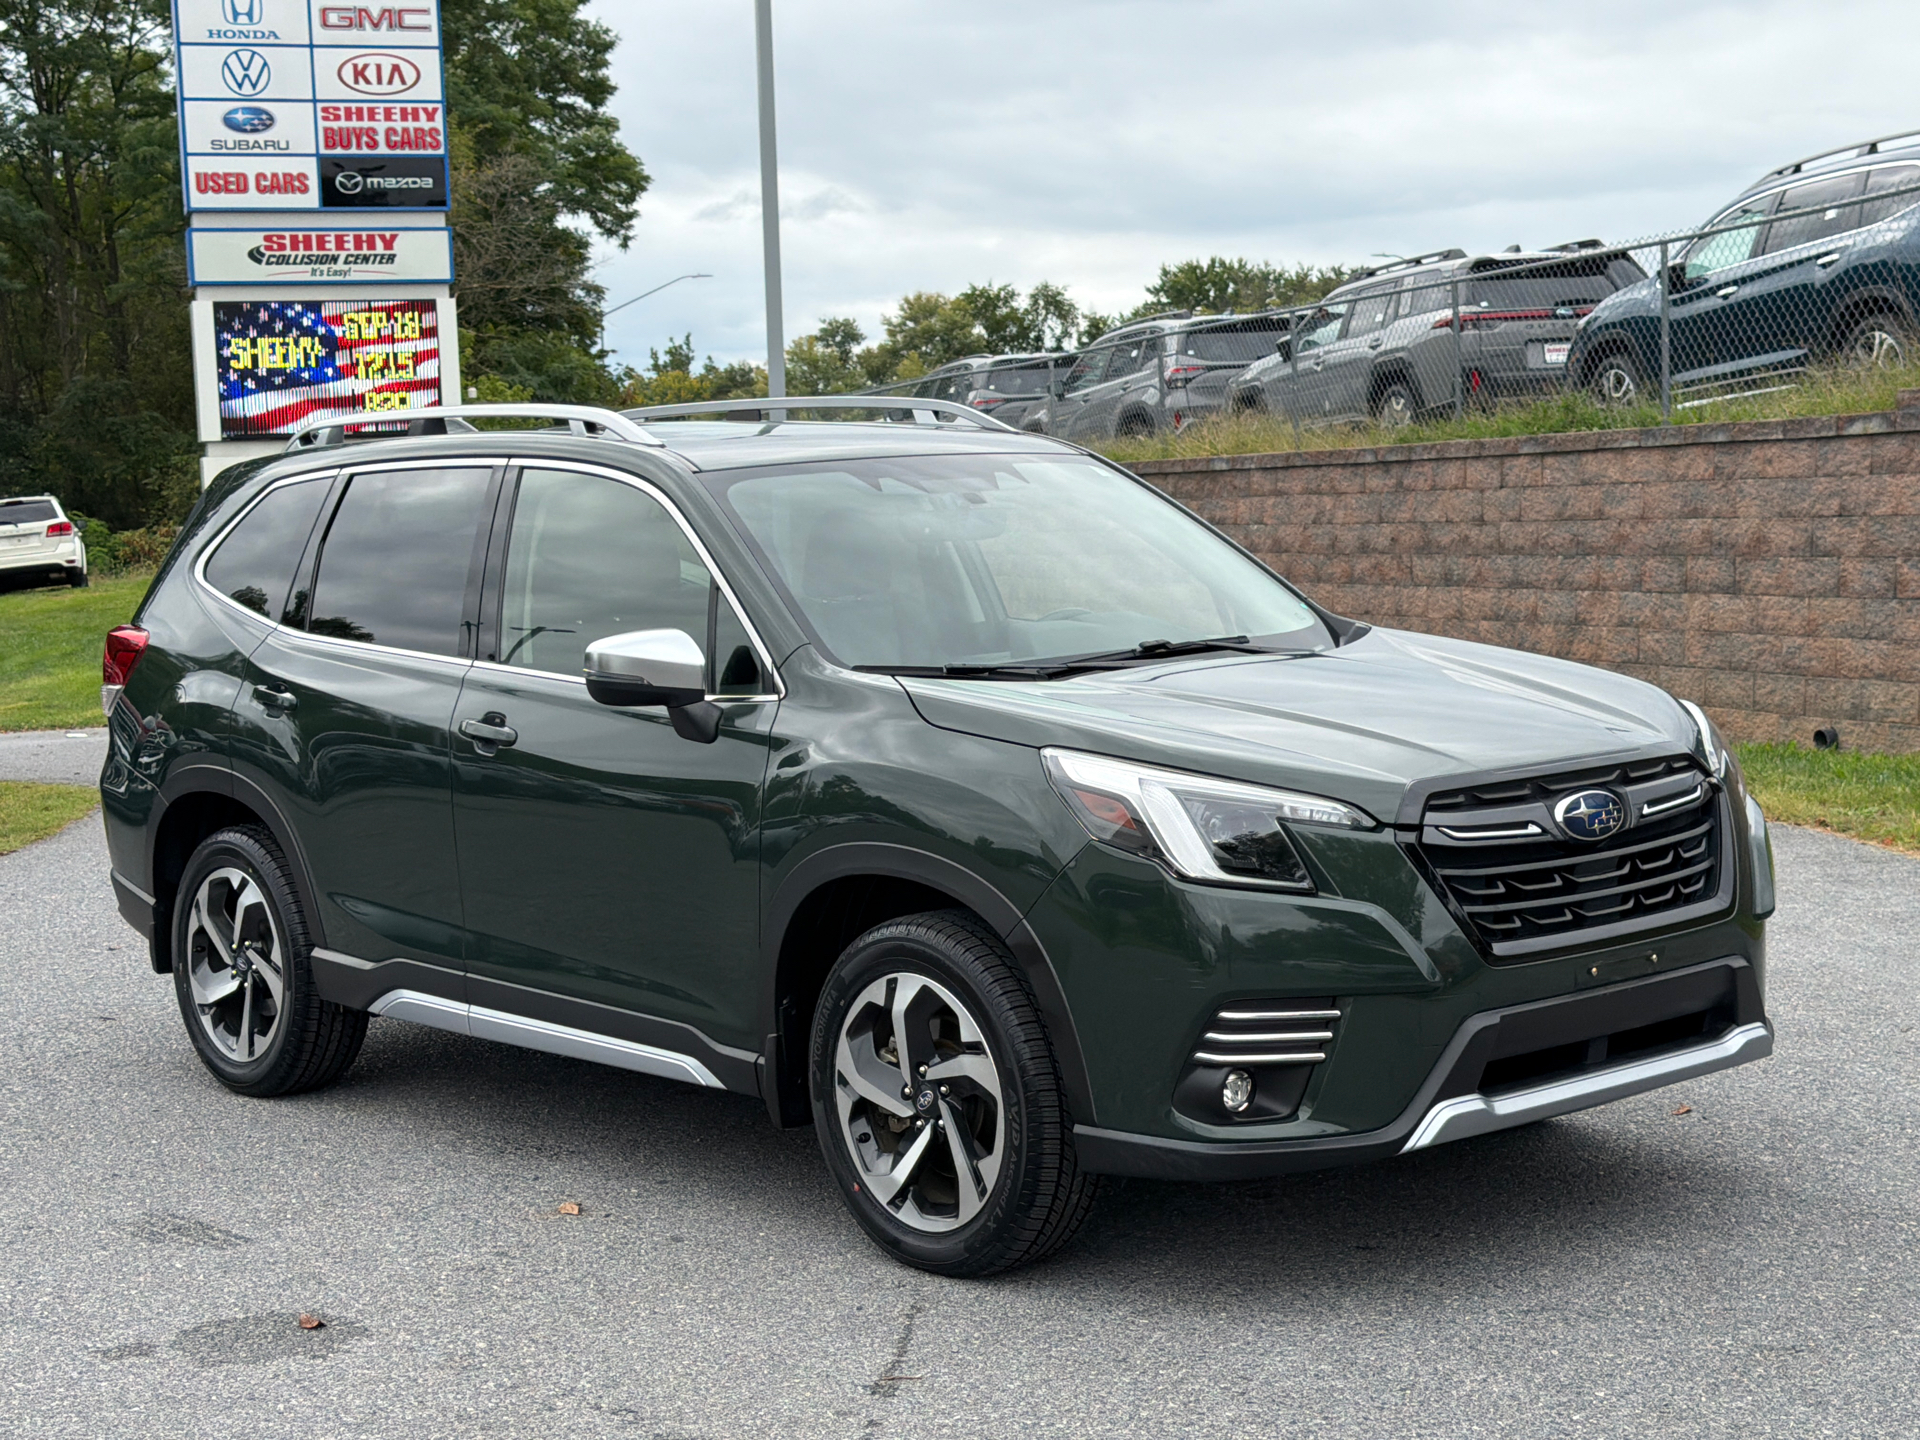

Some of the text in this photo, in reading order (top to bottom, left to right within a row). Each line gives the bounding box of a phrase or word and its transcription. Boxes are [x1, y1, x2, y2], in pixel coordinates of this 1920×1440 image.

[320, 6, 432, 32] GMC
[207, 29, 281, 40] HONDA
[352, 63, 408, 86] KIA
[320, 106, 440, 123] SHEEHY
[210, 139, 290, 151] SUBARU
[323, 126, 442, 151] BUYS CARS
[195, 172, 310, 195] USED CARS
[263, 233, 399, 252] SHEEHY
[265, 253, 397, 266] COLLISION CENTER
[310, 267, 352, 279] It's Easy!
